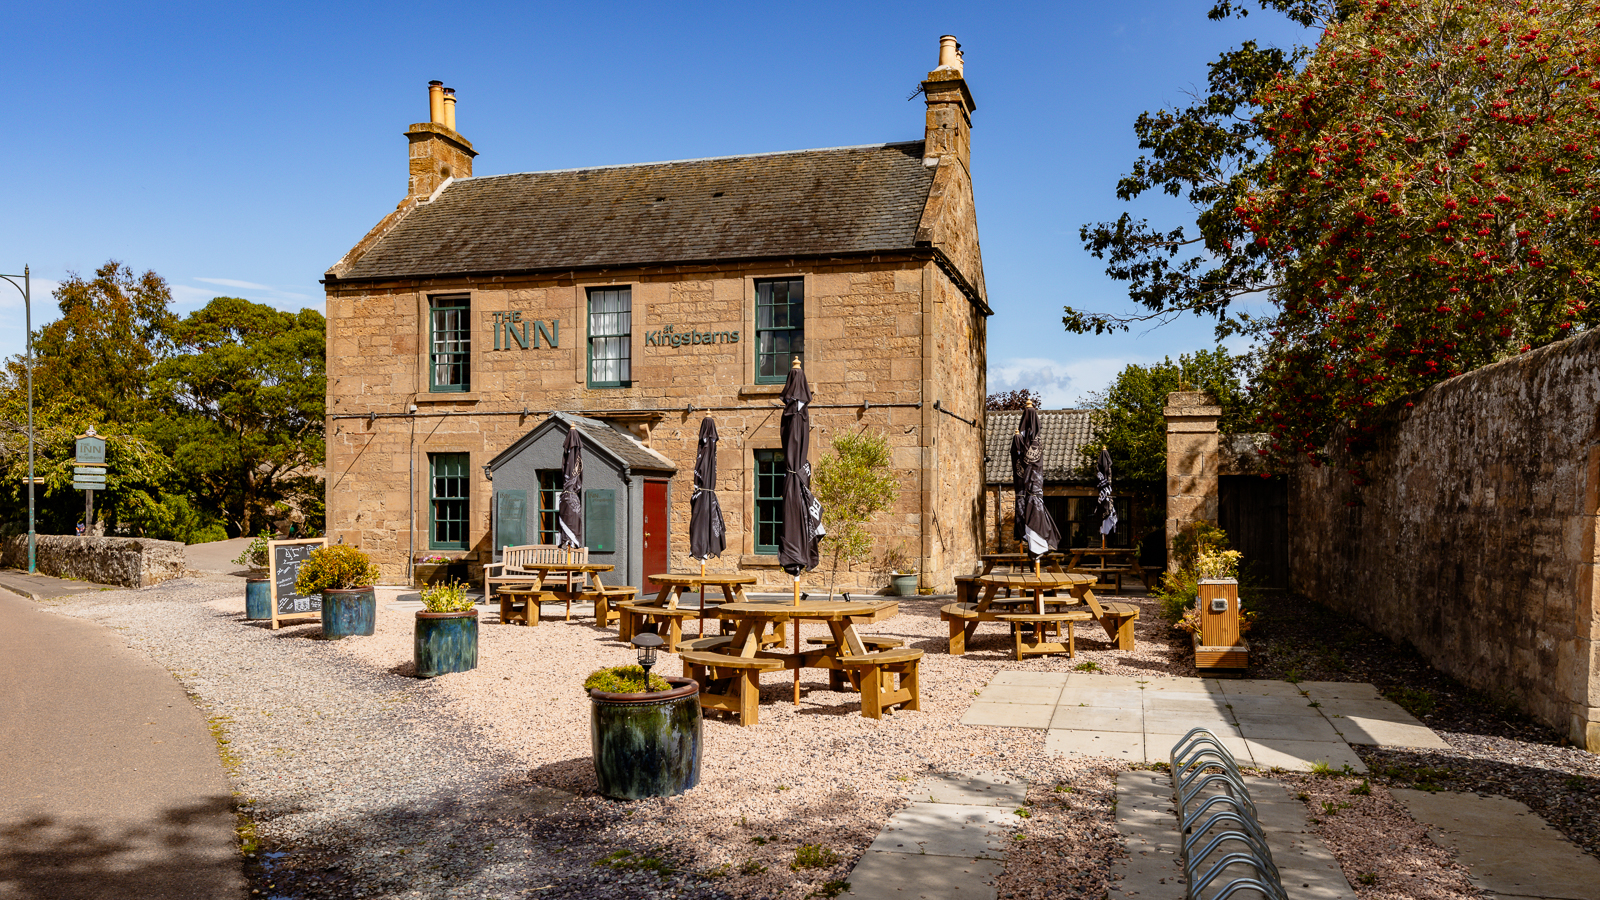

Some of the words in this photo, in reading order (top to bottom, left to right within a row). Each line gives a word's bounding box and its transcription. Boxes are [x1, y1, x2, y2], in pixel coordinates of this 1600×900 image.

[492, 311, 522, 322] THE
[664, 323, 674, 332] at
[493, 320, 559, 350] INN
[646, 329, 740, 347] Kingsbarns
